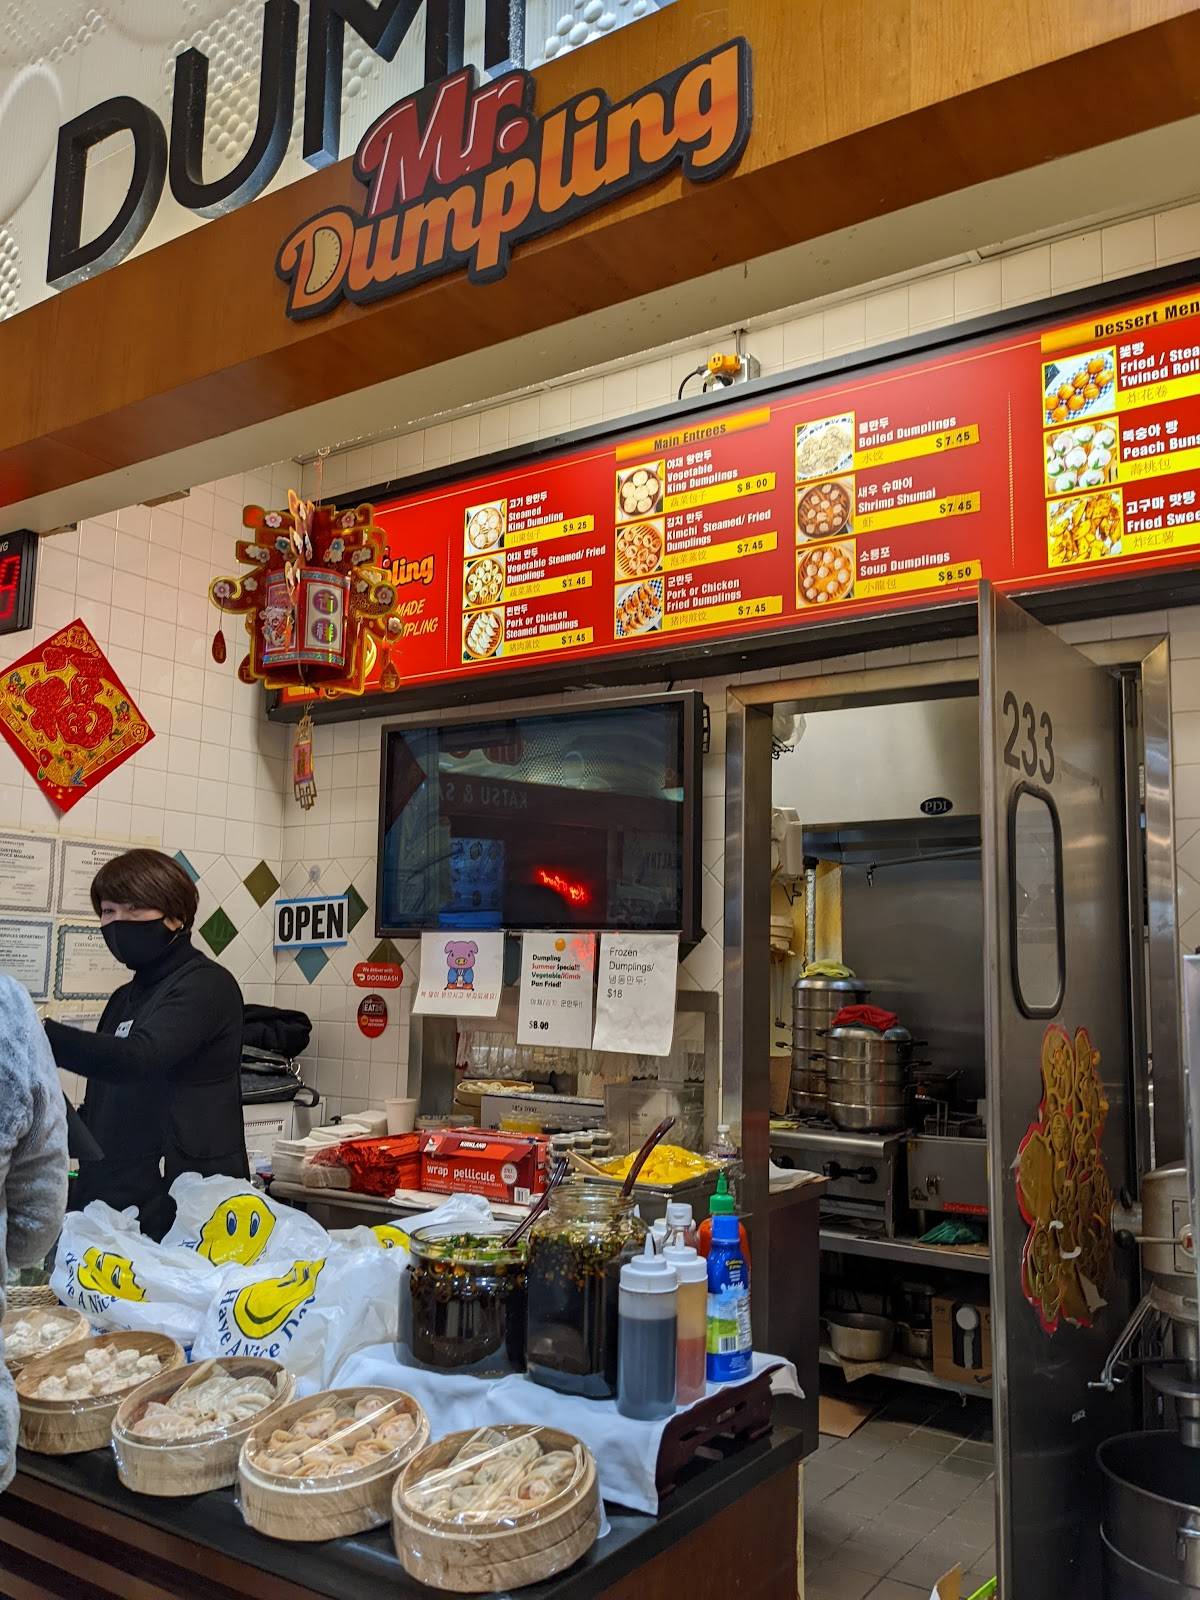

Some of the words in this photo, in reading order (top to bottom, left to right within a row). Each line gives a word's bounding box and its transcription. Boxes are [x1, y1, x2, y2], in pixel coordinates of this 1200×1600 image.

[46, 0, 525, 288] DUM
[358, 66, 530, 214] Mr.
[279, 43, 740, 311] Dumpling
[1094, 310, 1159, 338] Dessert
[1165, 301, 1200, 319] Men
[1120, 355, 1155, 374] Fried
[1169, 346, 1200, 361] Stea
[1121, 366, 1168, 387] Twined
[1172, 358, 1200, 375] Roll
[654, 435, 679, 451] Main
[683, 424, 726, 443] Entrees
[859, 431, 894, 448] Boiled
[897, 416, 956, 439] Dumplings
[687, 450, 711, 465] 왕만두
[1123, 440, 1165, 460] Peach
[667, 464, 712, 482] Vegetable
[667, 481, 686, 494] King
[690, 469, 738, 489] Dumplings
[858, 484, 877, 499] 새우
[882, 476, 913, 493] 슈마이
[509, 497, 523, 509] 고기
[525, 491, 547, 506] 왕만두
[858, 497, 894, 513] Shrimp
[897, 487, 936, 505] Shumai
[1126, 497, 1164, 515] 고구마
[508, 505, 541, 522] Steamed
[508, 521, 525, 533] King
[527, 512, 563, 529] Dumpling
[667, 514, 683, 528] 김치
[686, 510, 703, 524] 만두
[1127, 515, 1162, 533] Fried
[1167, 510, 1200, 526] Swee
[667, 525, 698, 541] Kimchi
[703, 514, 745, 533] Steamed/
[748, 509, 771, 524] Fried
[667, 535, 712, 553] Dumplings
[507, 550, 521, 562] 야채
[523, 547, 538, 559] 만두
[507, 558, 546, 574] Vegetable
[548, 549, 584, 566] Steamed/
[585, 545, 606, 558] Fried
[860, 562, 887, 577] Soup
[890, 551, 950, 571] Dumplings
[507, 570, 545, 585] Dumplings
[667, 573, 693, 587] 군만두
[667, 588, 686, 601] Pork
[689, 586, 698, 596] or
[701, 579, 740, 594] Chicken
[667, 597, 689, 612] Fried
[693, 590, 742, 607] Dumplings
[506, 618, 523, 629] Pork
[525, 616, 534, 624] or
[536, 611, 567, 623] Chicken
[506, 625, 538, 639] Steamed
[539, 620, 578, 634] Dumplings
[1003, 690, 1054, 785] 233
[924, 800, 948, 812] PDI
[278, 903, 344, 942] OPEN
[532, 954, 561, 962] Dumpling
[609, 947, 638, 957] Frozen
[544, 980, 561, 988] Fried!
[607, 988, 623, 999] $18
[459, 1141, 487, 1150] KIRKLAND
[427, 1165, 448, 1177] wrap
[453, 1168, 496, 1183] pellicule
[78, 1291, 87, 1311] A
[218, 1288, 240, 1346] Have
[225, 1339, 242, 1357] A
[243, 1342, 281, 1359] Nice
